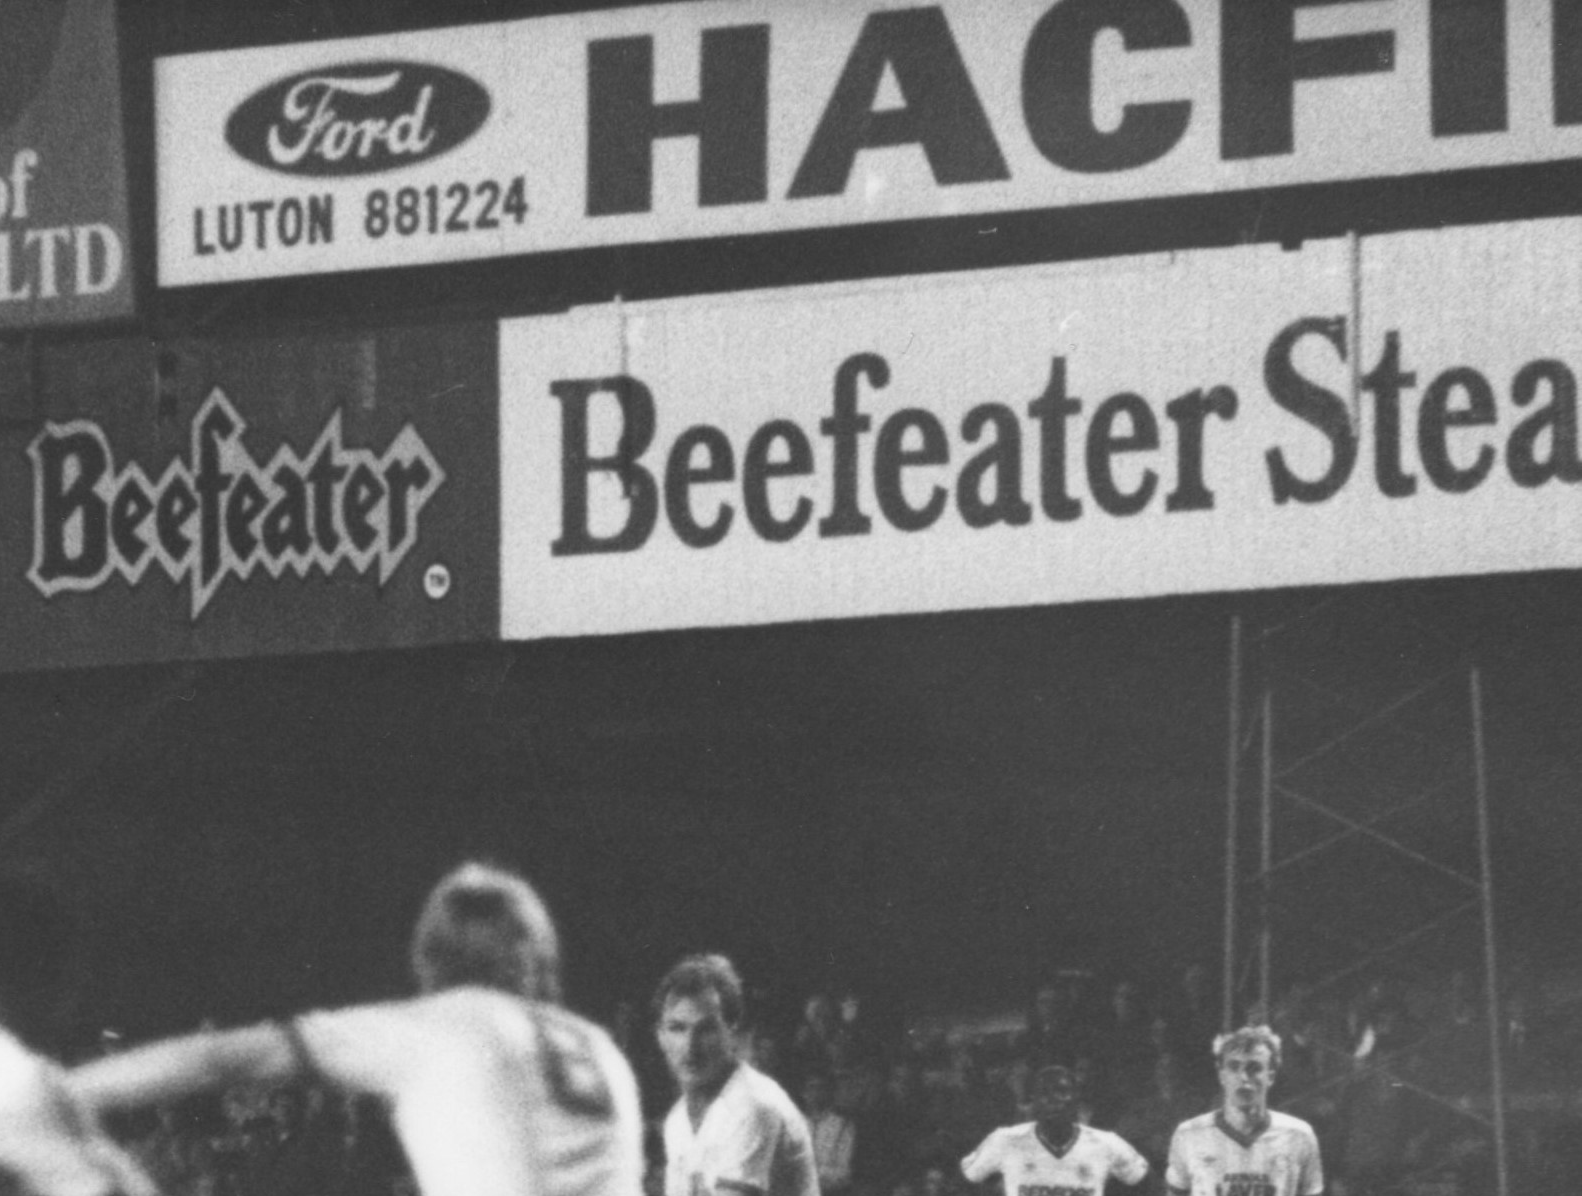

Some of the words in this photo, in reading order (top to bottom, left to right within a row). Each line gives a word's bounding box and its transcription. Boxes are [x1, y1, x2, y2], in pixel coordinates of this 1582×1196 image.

[268, 69, 435, 165] Ford
[193, 192, 335, 256] LUTON
[363, 174, 529, 239] 881224
[26, 386, 447, 621] Beefeater
[549, 352, 1240, 557] Beefeater
[1260, 314, 1582, 507] Stea
